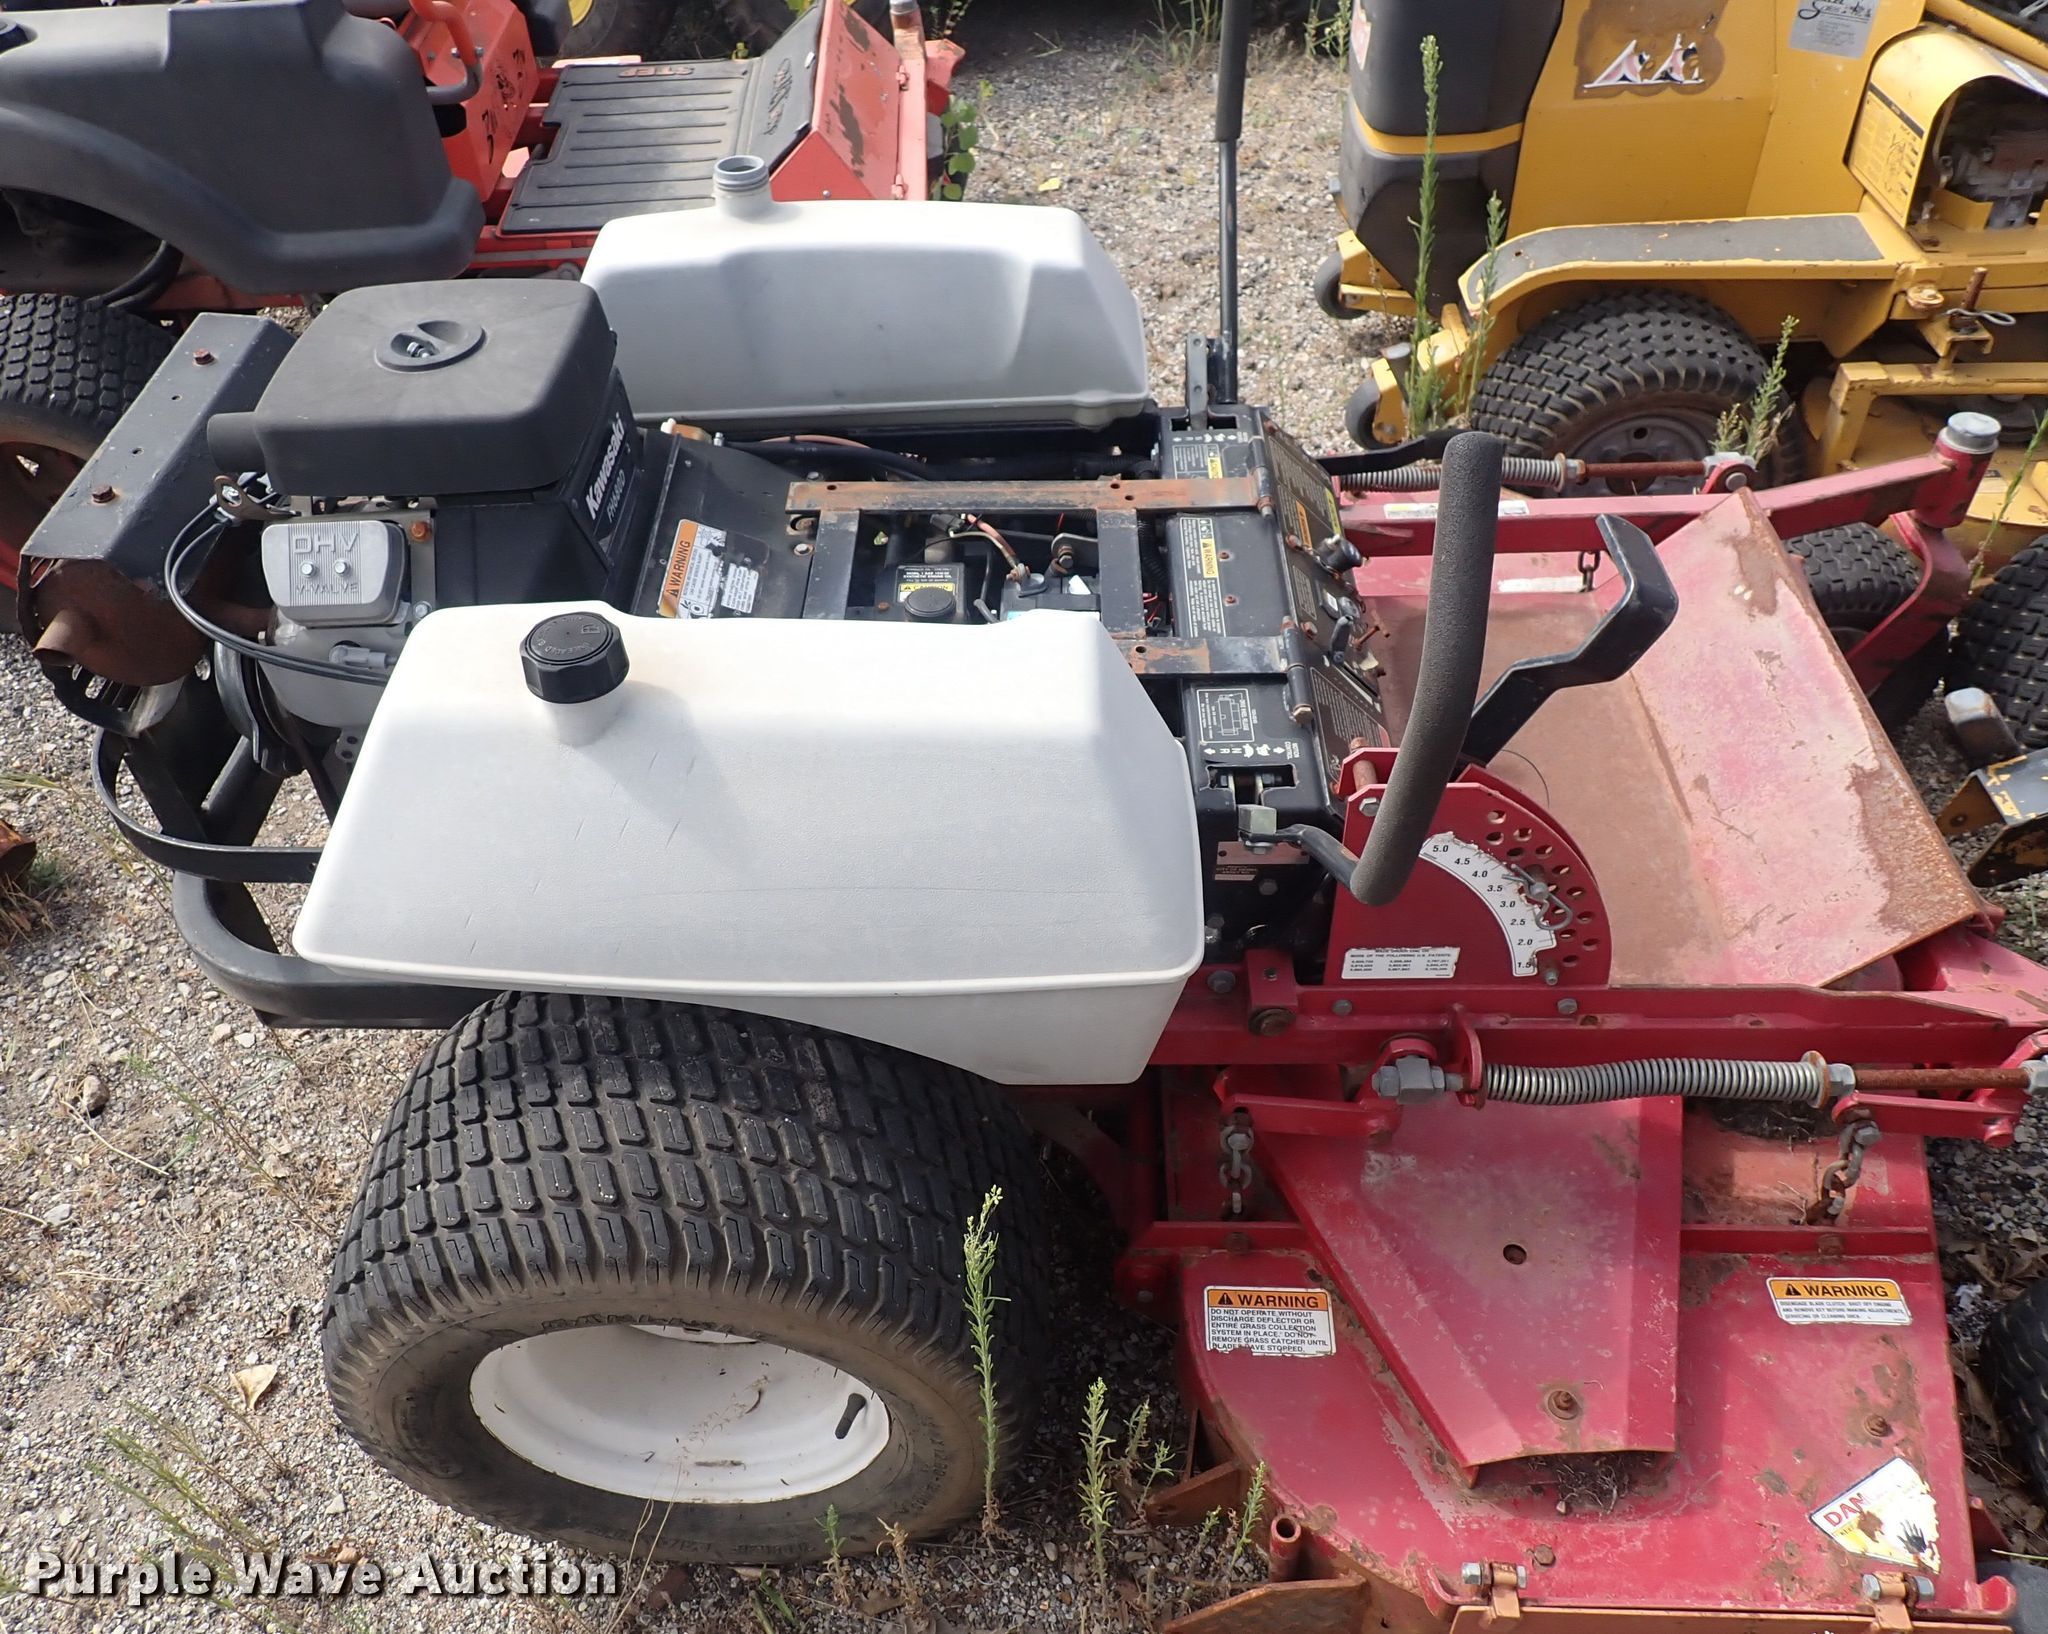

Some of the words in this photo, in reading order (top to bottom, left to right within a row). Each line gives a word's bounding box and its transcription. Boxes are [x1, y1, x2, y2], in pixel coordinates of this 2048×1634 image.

[585, 412, 625, 520] Kawasaki
[669, 540, 691, 588] WARNING
[1432, 844, 1449, 853] 5.0
[1454, 857, 1471, 866] 4.5
[1472, 870, 1488, 878] 4.0
[1487, 884, 1503, 892] 3.5
[1500, 900, 1516, 908] 3.0
[1510, 918, 1526, 926] 2.5
[1517, 938, 1533, 946] 2.0
[1517, 961, 1532, 969] 1.5
[1803, 1284, 1888, 1297] WARNING
[1238, 1293, 1319, 1308] WARNING
[1256, 1316, 1302, 1324] DEFLECTOR
